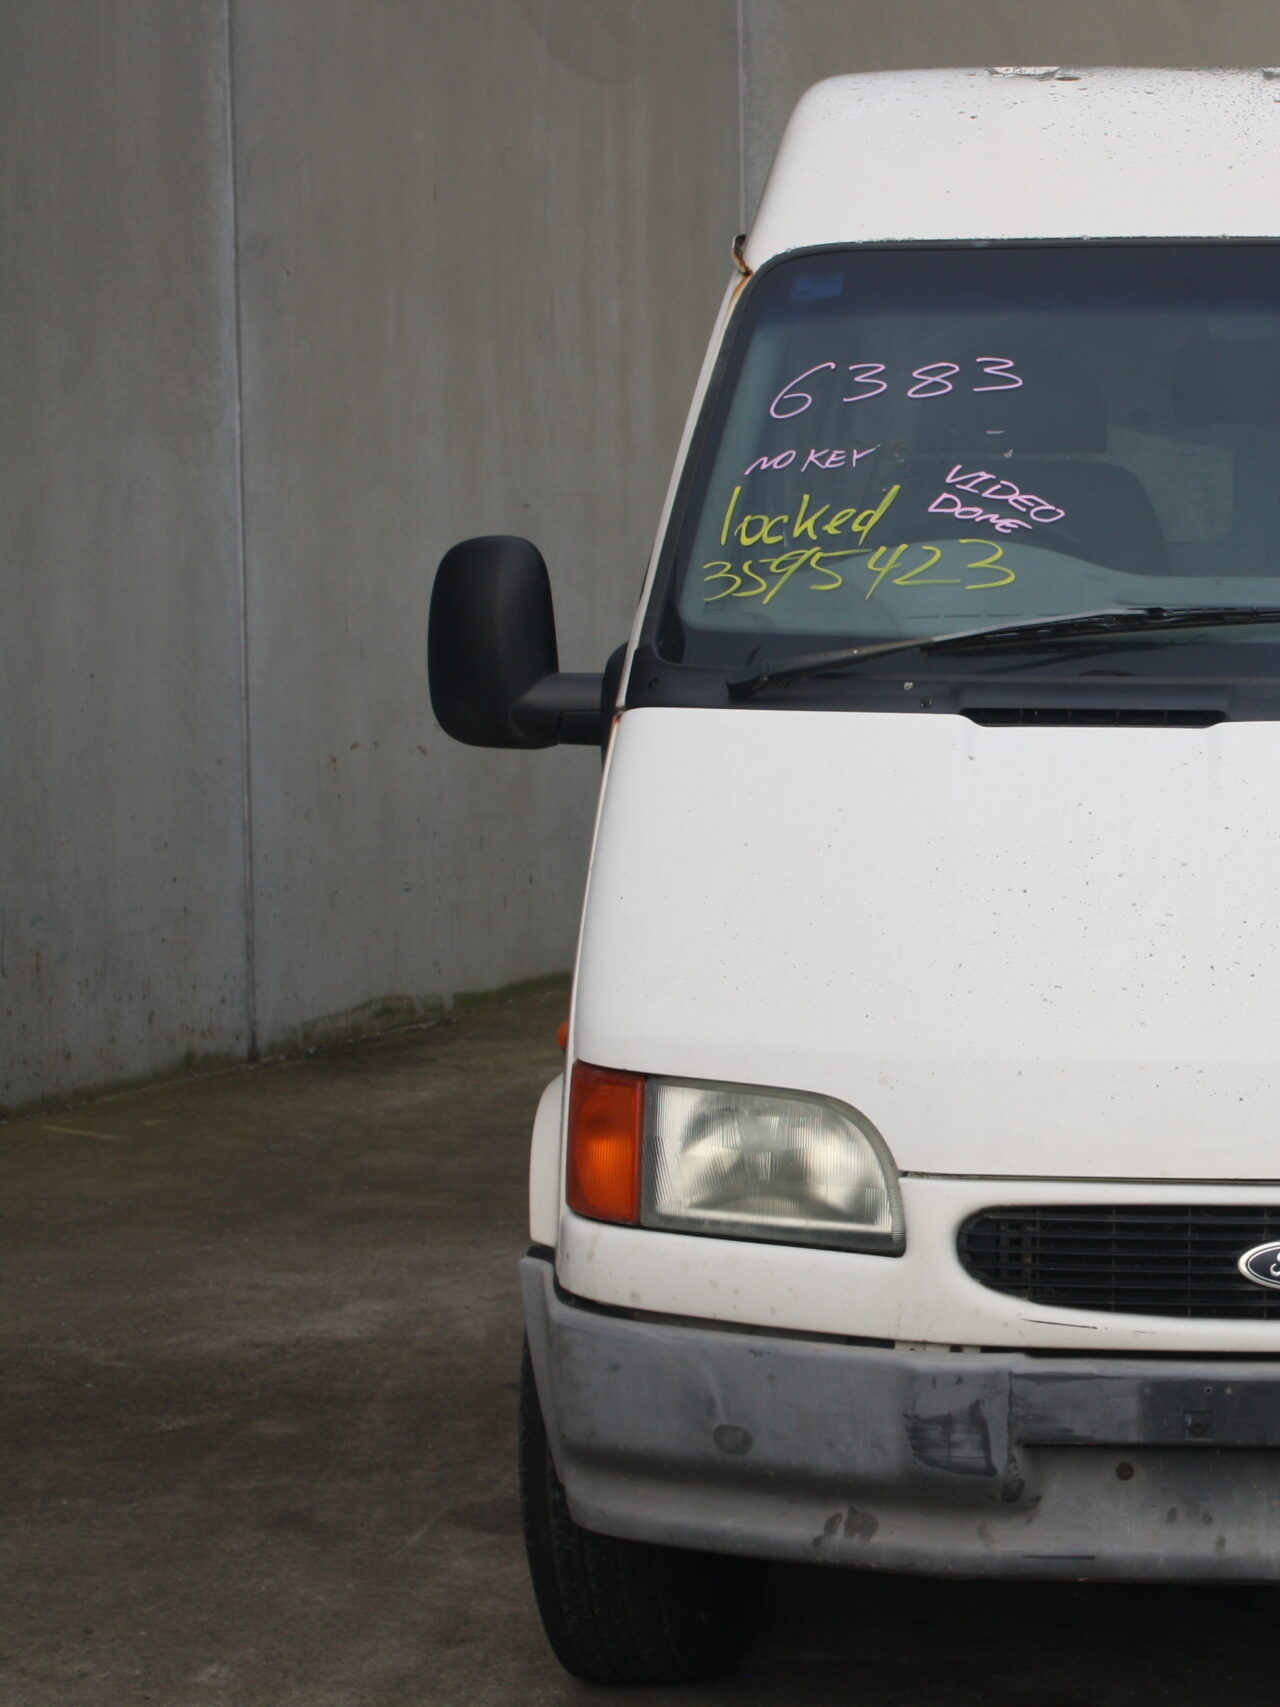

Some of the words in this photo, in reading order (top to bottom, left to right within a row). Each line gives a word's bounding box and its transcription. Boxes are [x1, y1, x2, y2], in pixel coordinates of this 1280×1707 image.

[769, 356, 1024, 419] 6383
[801, 445, 880, 472] KEY
[720, 485, 901, 546] locked
[945, 465, 1066, 524] VIDEO
